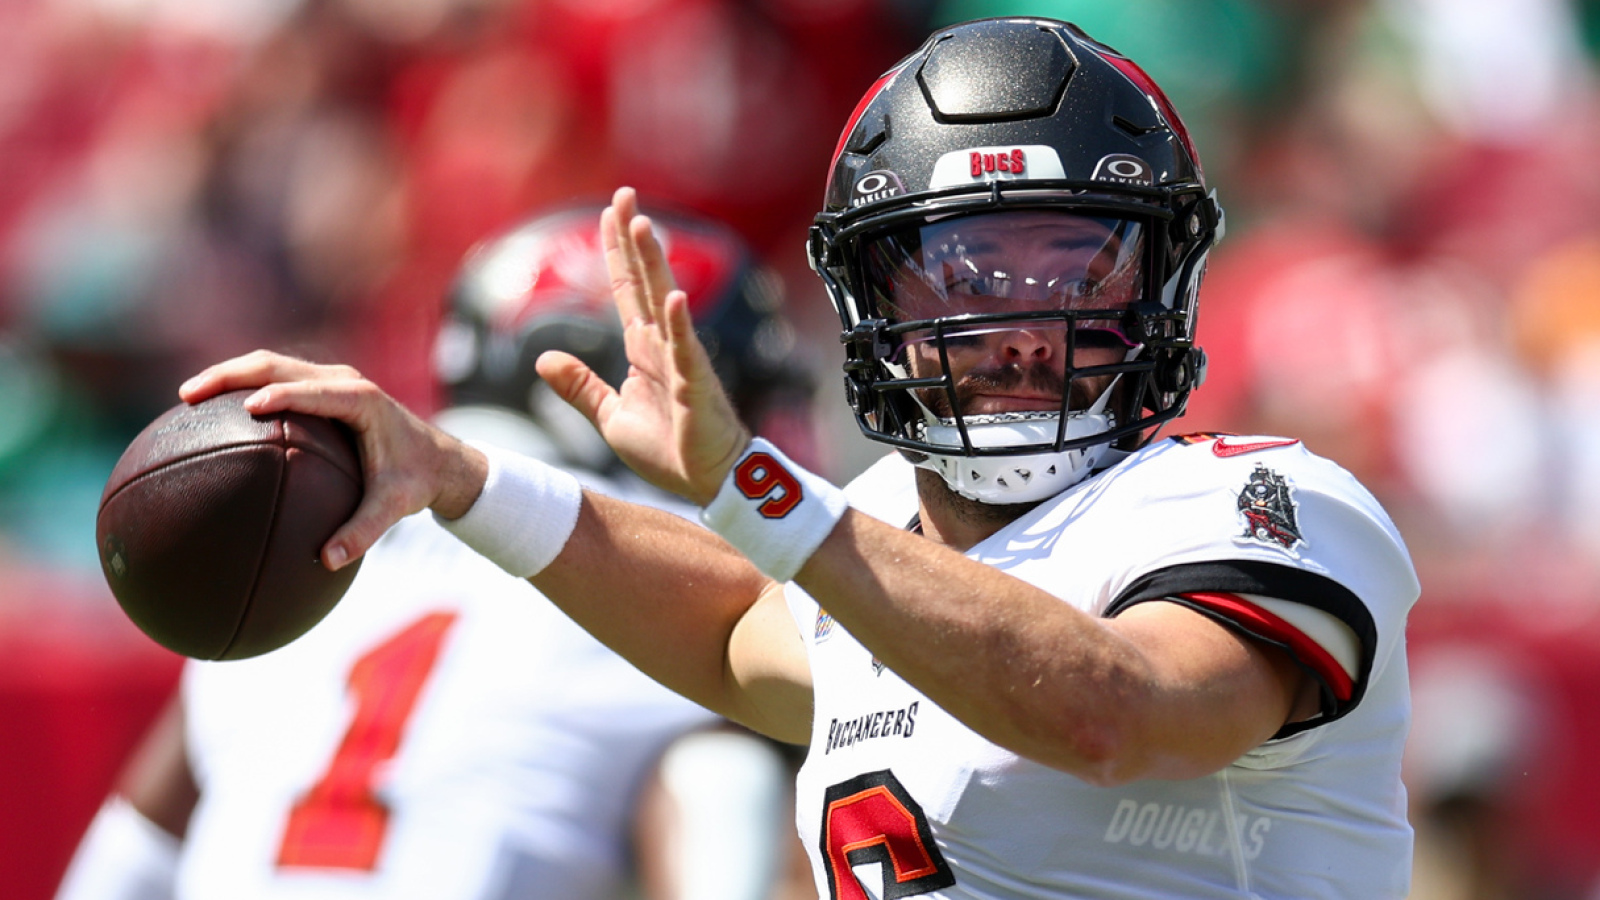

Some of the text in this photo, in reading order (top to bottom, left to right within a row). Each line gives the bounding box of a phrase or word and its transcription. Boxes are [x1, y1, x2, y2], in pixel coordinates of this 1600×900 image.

[969, 149, 1024, 177] BUCS
[853, 187, 898, 208] OAKLEY
[277, 612, 459, 871] 1
[825, 701, 919, 755] BUCCANEERS
